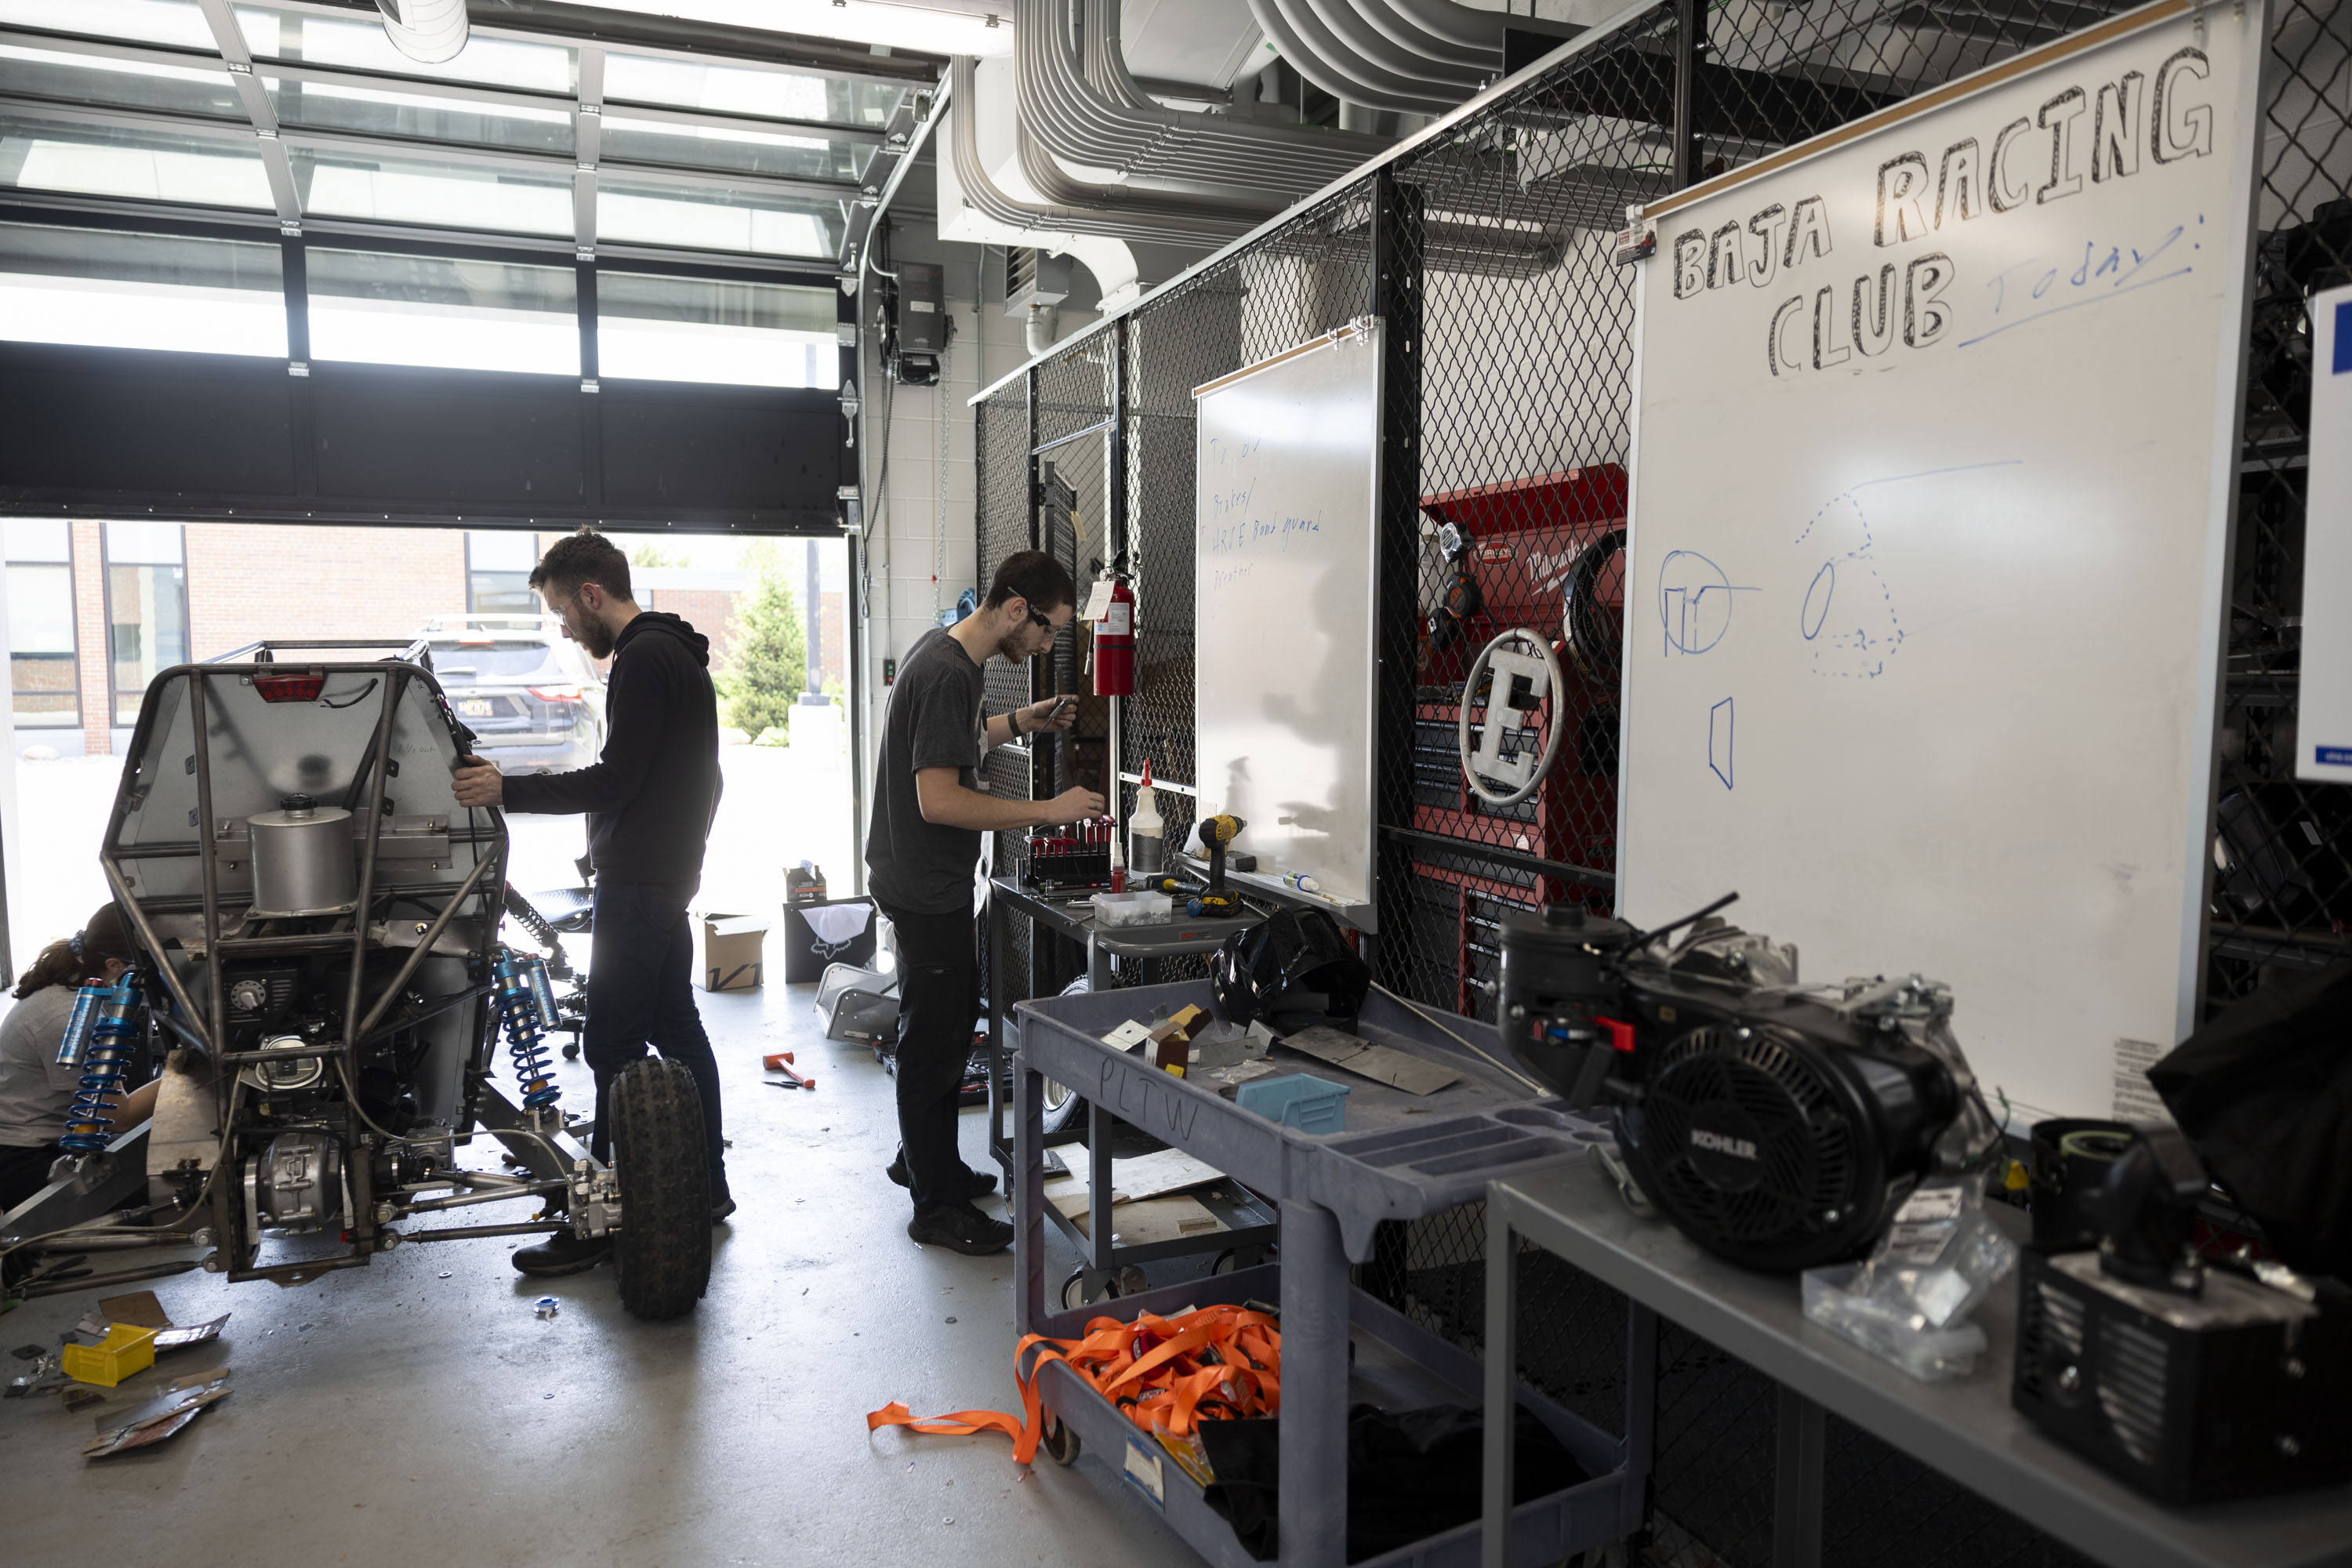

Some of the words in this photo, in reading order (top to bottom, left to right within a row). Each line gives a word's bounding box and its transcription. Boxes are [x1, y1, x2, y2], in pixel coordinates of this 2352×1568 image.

[1674, 194, 1832, 300] BAJA
[1874, 47, 2213, 248] RACING
[1769, 252, 1956, 376] CLUB
[1099, 1056, 1199, 1142] PLTW
[1691, 1128, 1757, 1160] KOHLER
